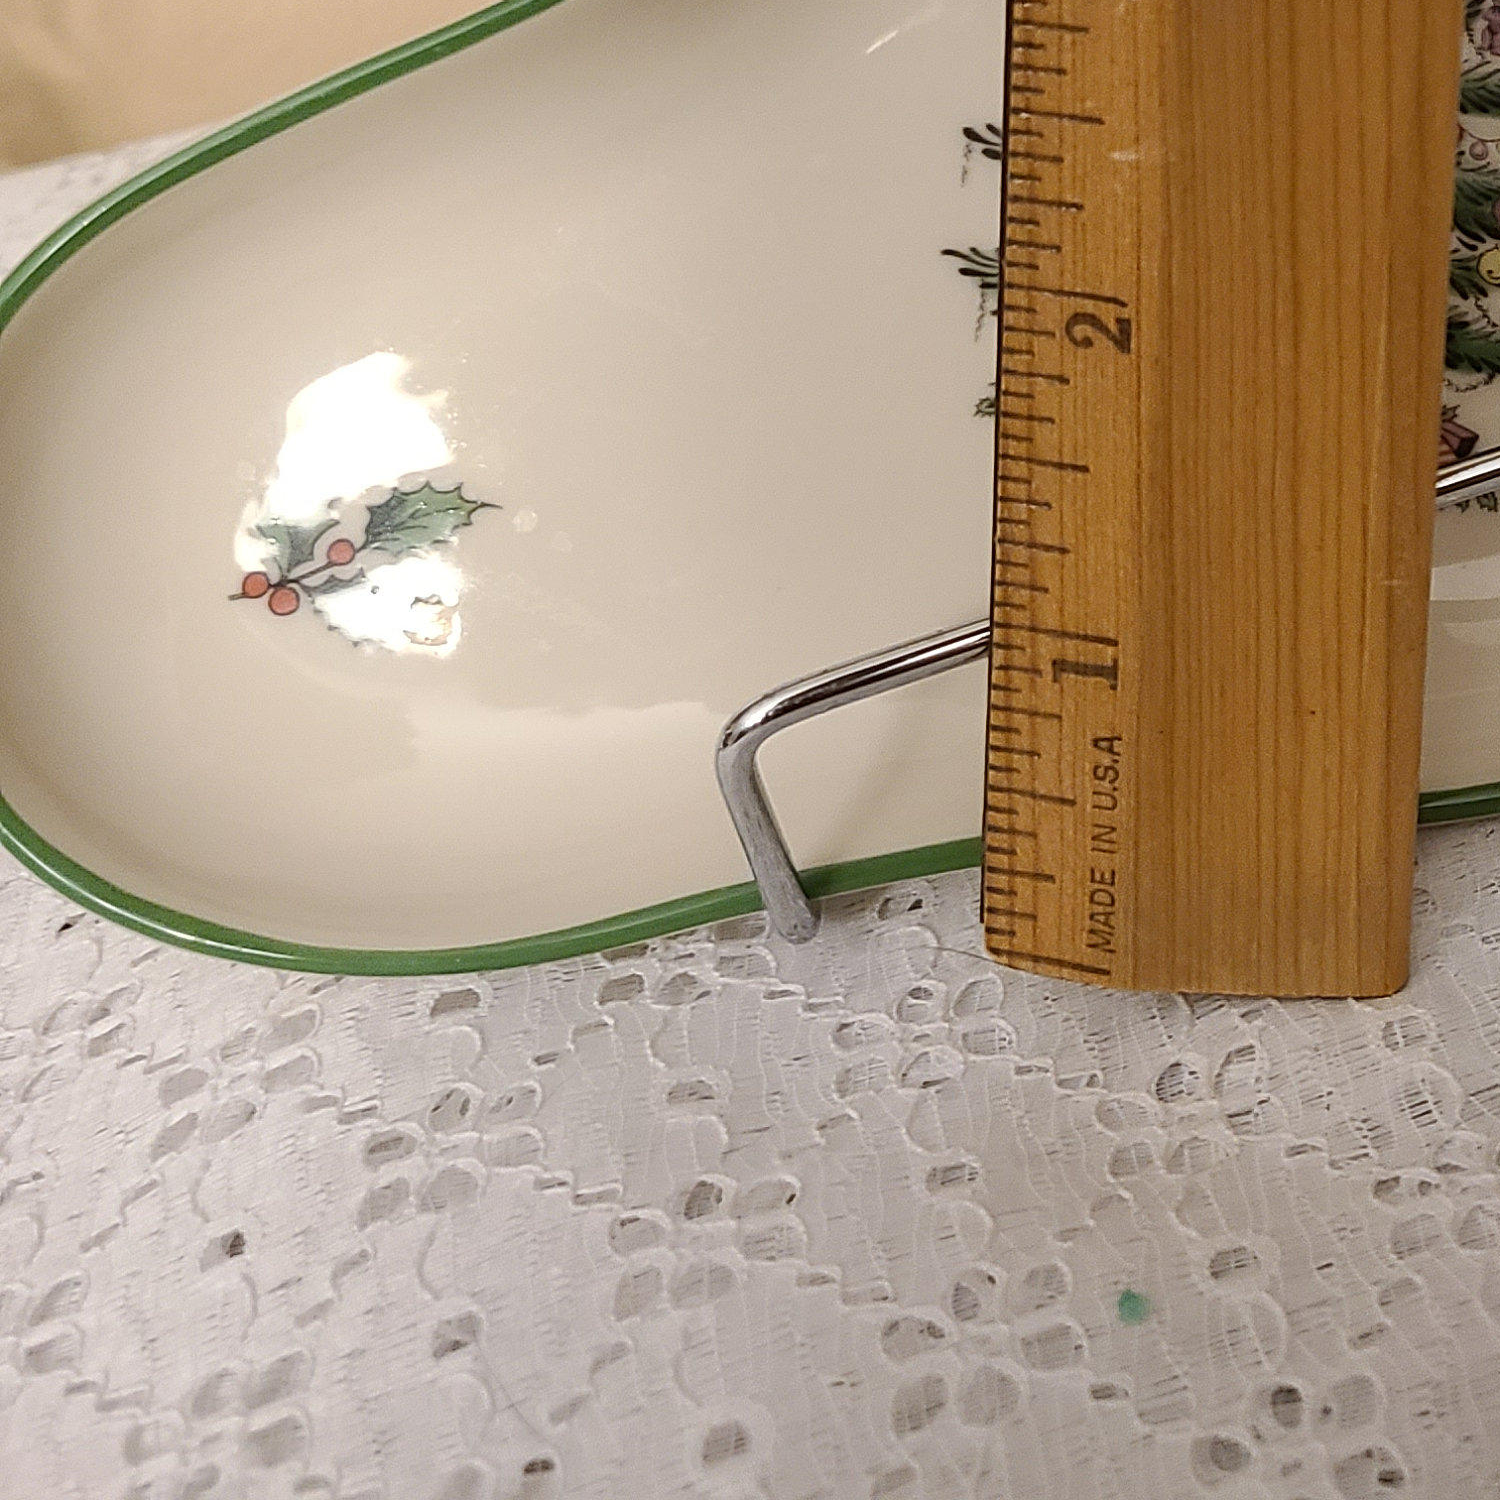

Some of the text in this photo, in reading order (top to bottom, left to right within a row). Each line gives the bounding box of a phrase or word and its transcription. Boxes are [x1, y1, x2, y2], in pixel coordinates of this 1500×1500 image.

[1064, 313, 1133, 355] 2
[1051, 656, 1120, 692] 1
[1090, 823, 1118, 855] IN
[1086, 867, 1117, 955] MADE
